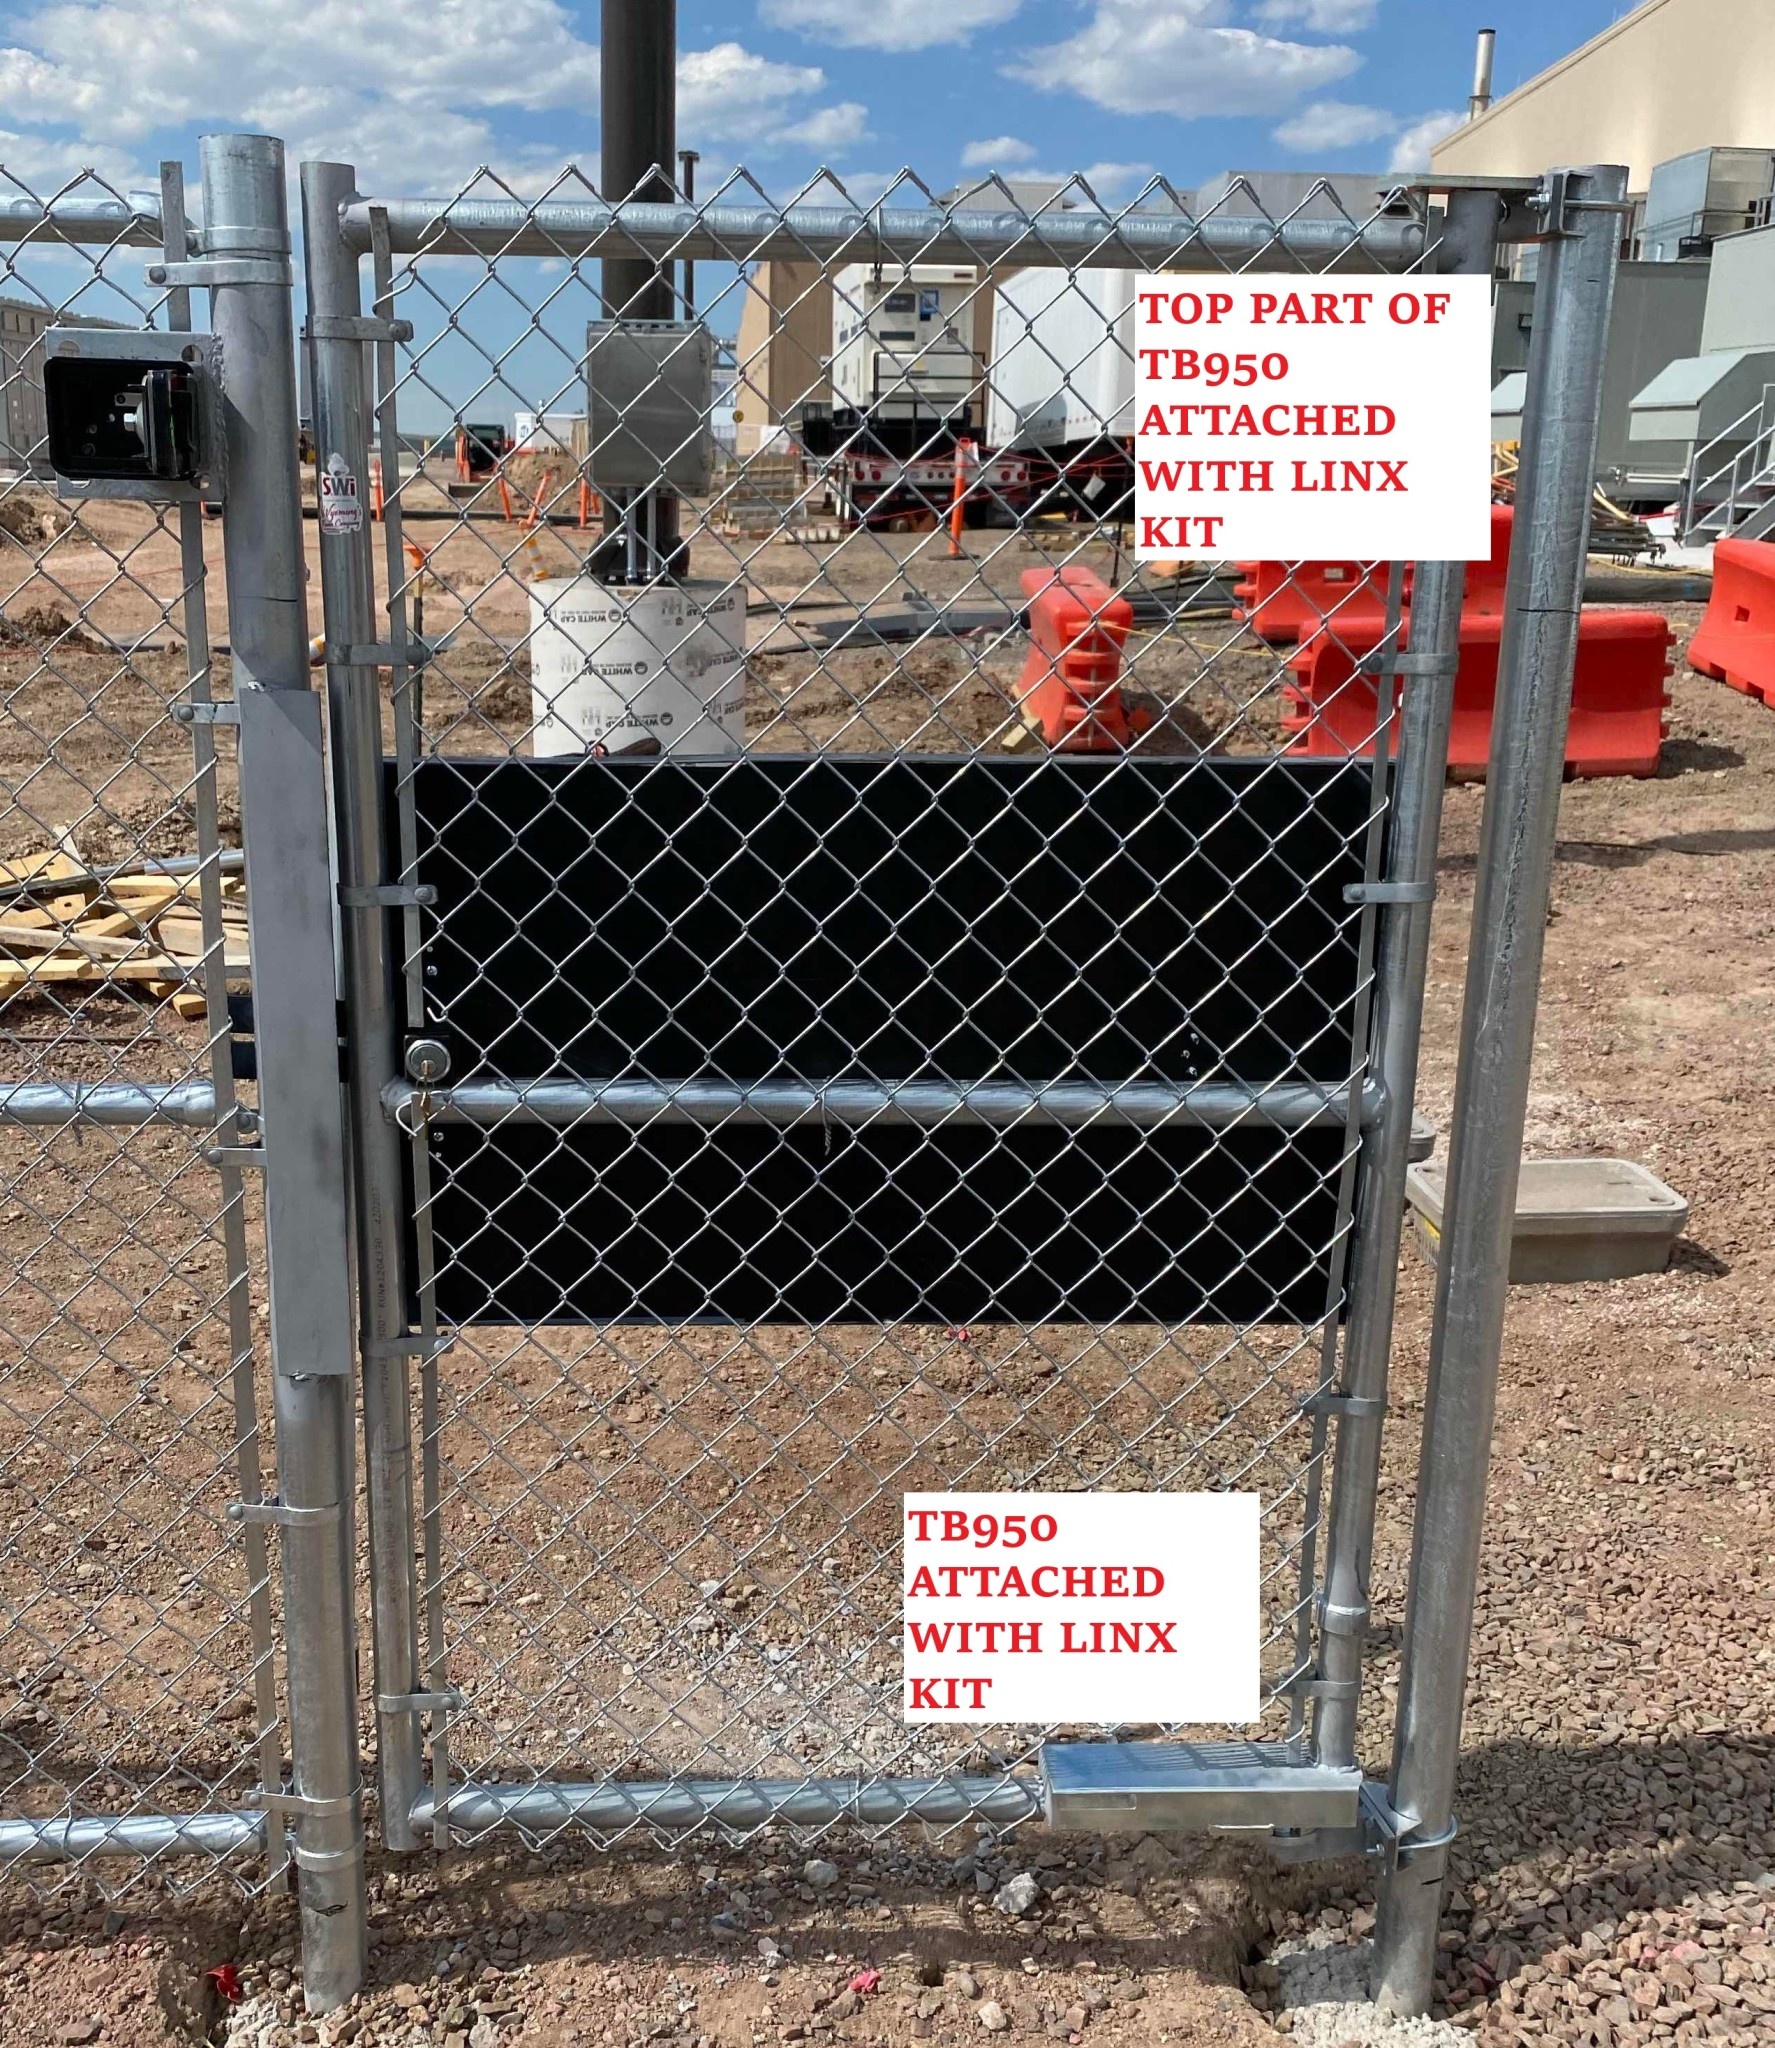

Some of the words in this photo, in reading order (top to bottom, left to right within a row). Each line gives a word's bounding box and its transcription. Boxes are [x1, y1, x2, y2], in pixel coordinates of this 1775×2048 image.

[560, 614, 576, 623] CAP
[577, 614, 606, 623] WHITE
[601, 667, 633, 675] WHITE
